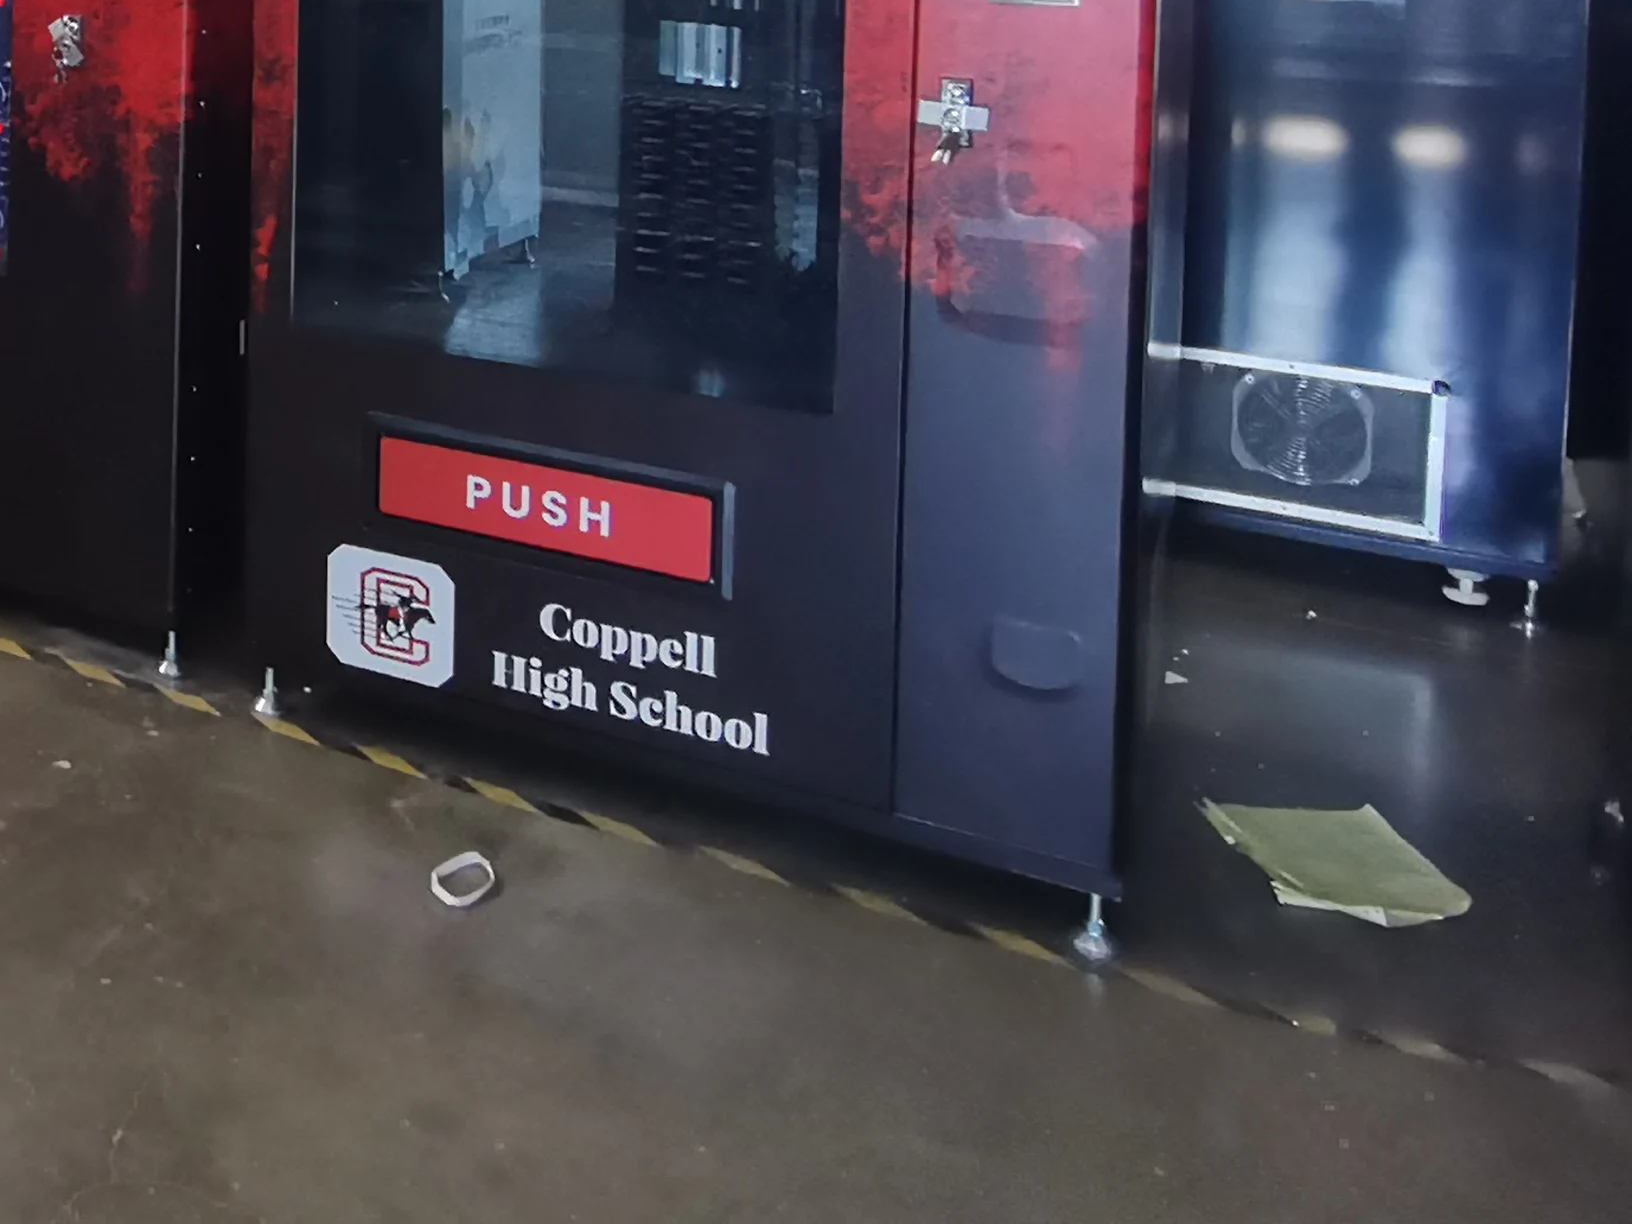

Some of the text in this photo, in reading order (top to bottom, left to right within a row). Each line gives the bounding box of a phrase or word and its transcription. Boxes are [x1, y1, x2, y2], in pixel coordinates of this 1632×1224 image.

[465, 473, 611, 538] PUSH
[538, 602, 718, 678] Coppell
[491, 650, 771, 757] High School
